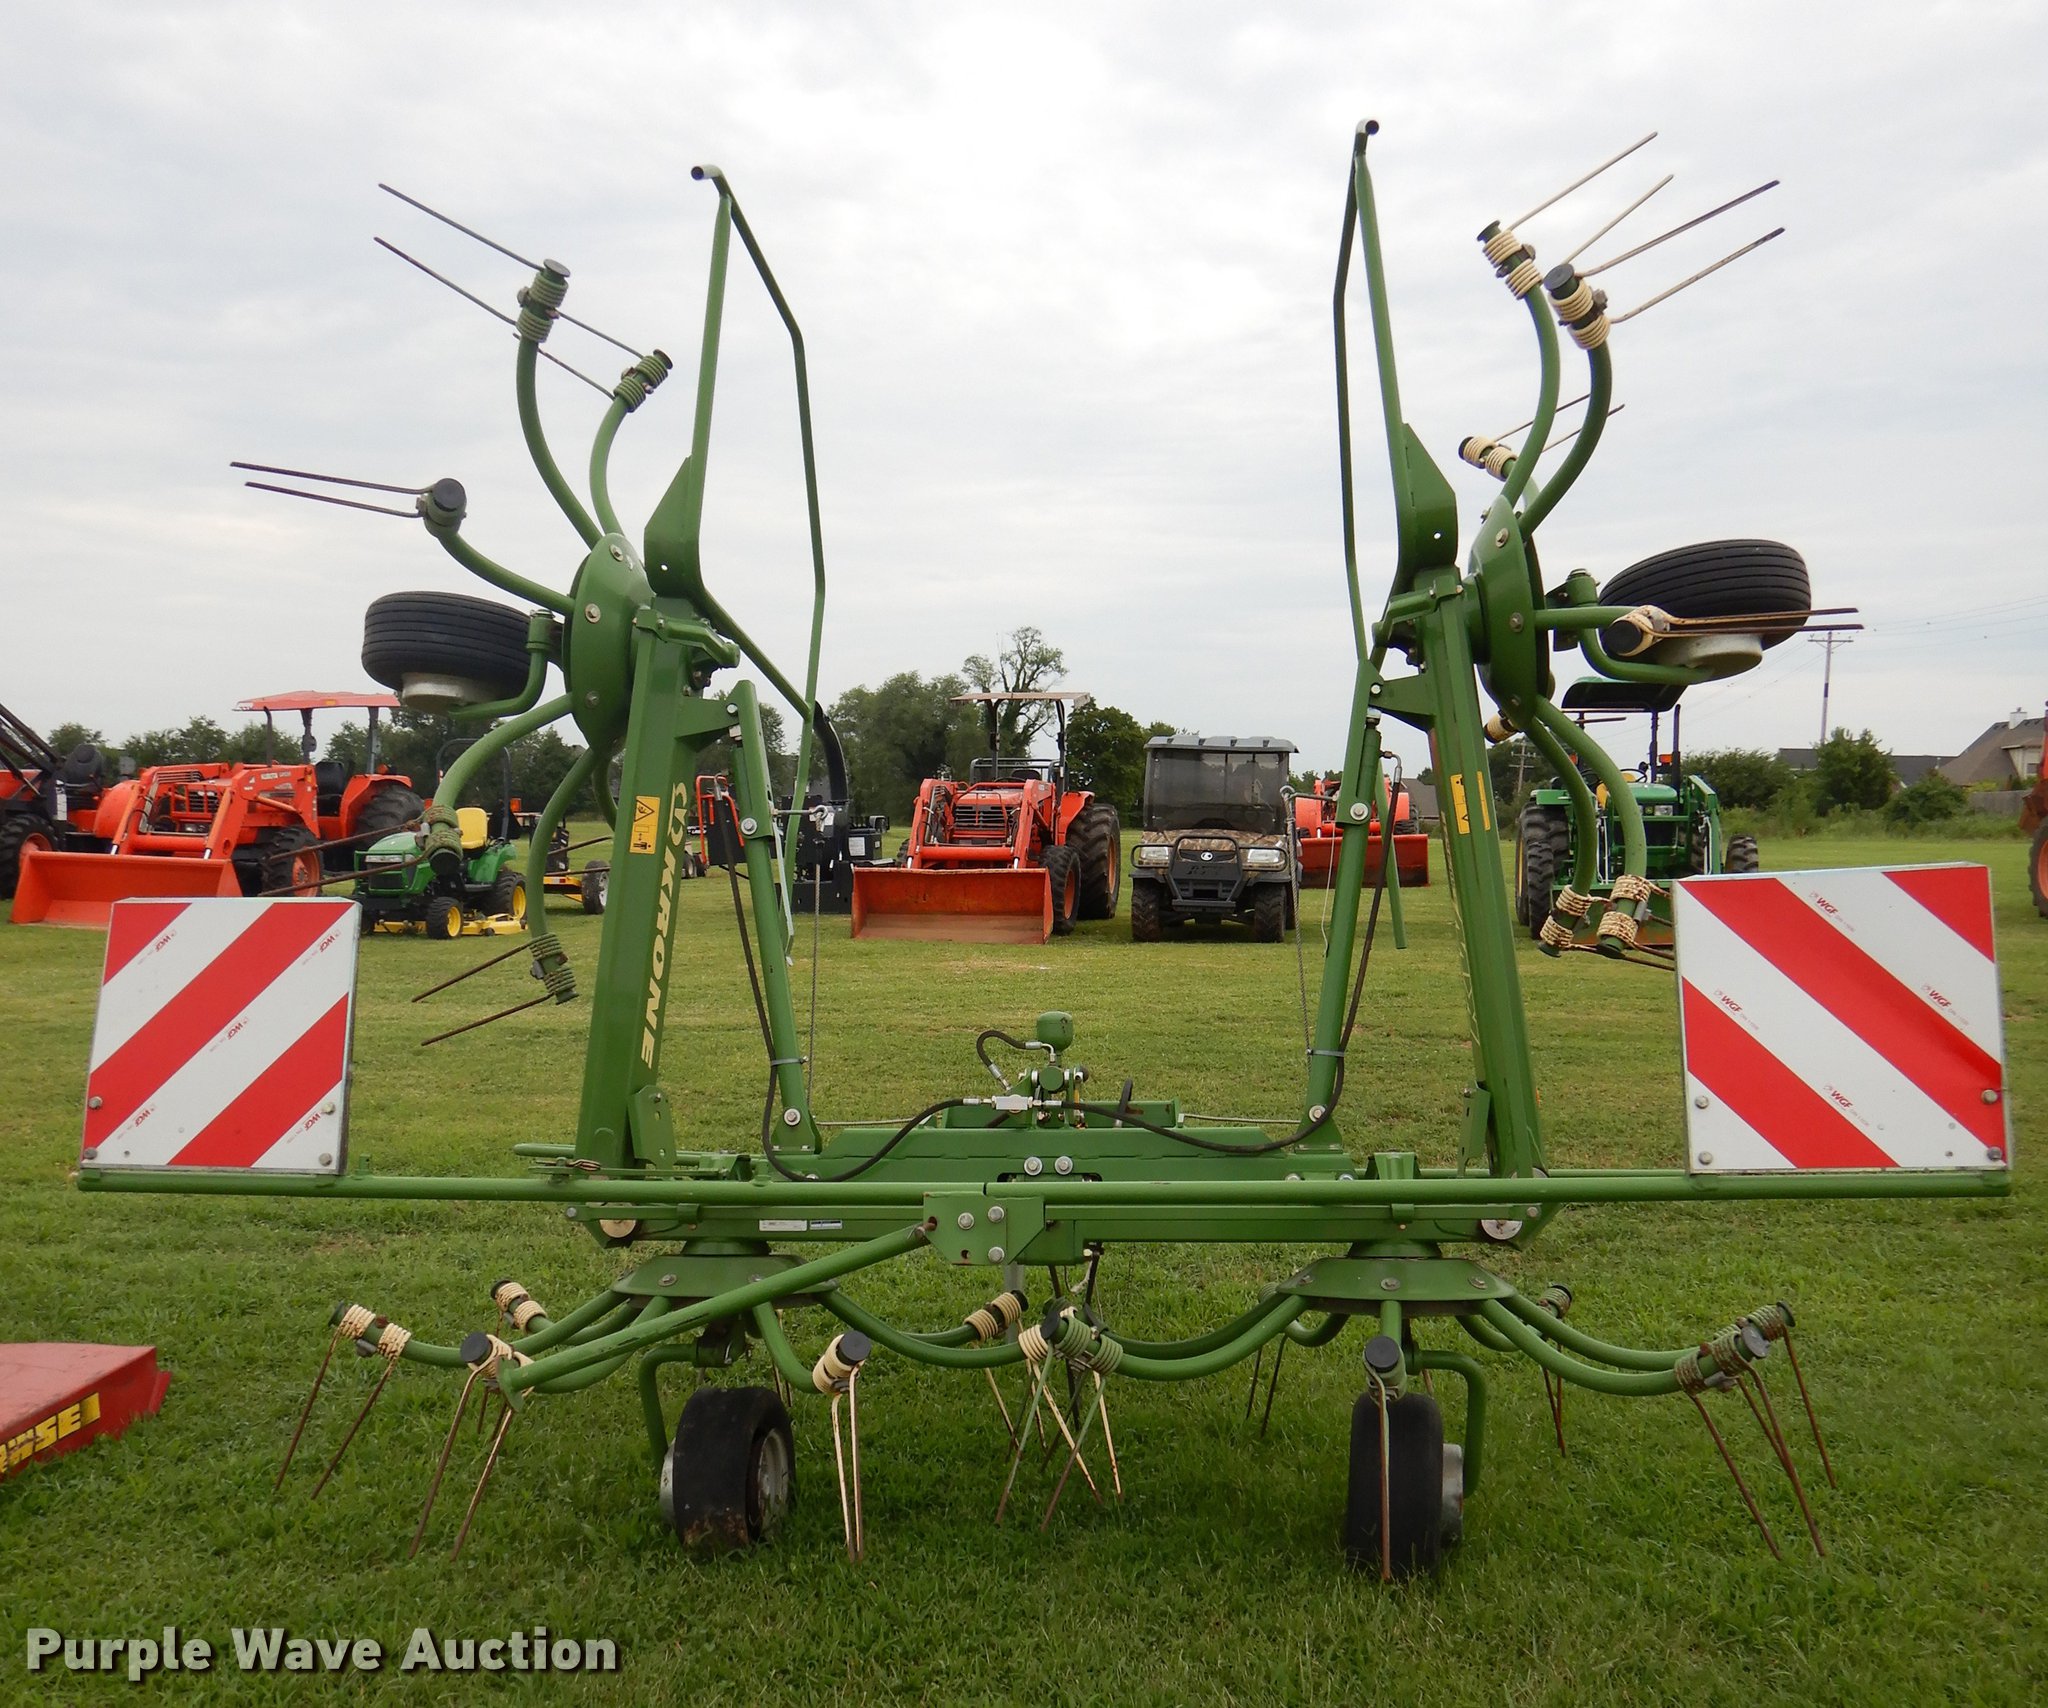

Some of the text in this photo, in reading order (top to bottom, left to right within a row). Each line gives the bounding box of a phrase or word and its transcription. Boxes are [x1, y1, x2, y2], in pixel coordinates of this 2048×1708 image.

[1817, 898, 1838, 913] WGF
[641, 846, 677, 1069] KRONE
[1722, 996, 1742, 1011] WGF
[1929, 990, 1952, 1007] WGF
[1831, 1091, 1853, 1107] WGF
